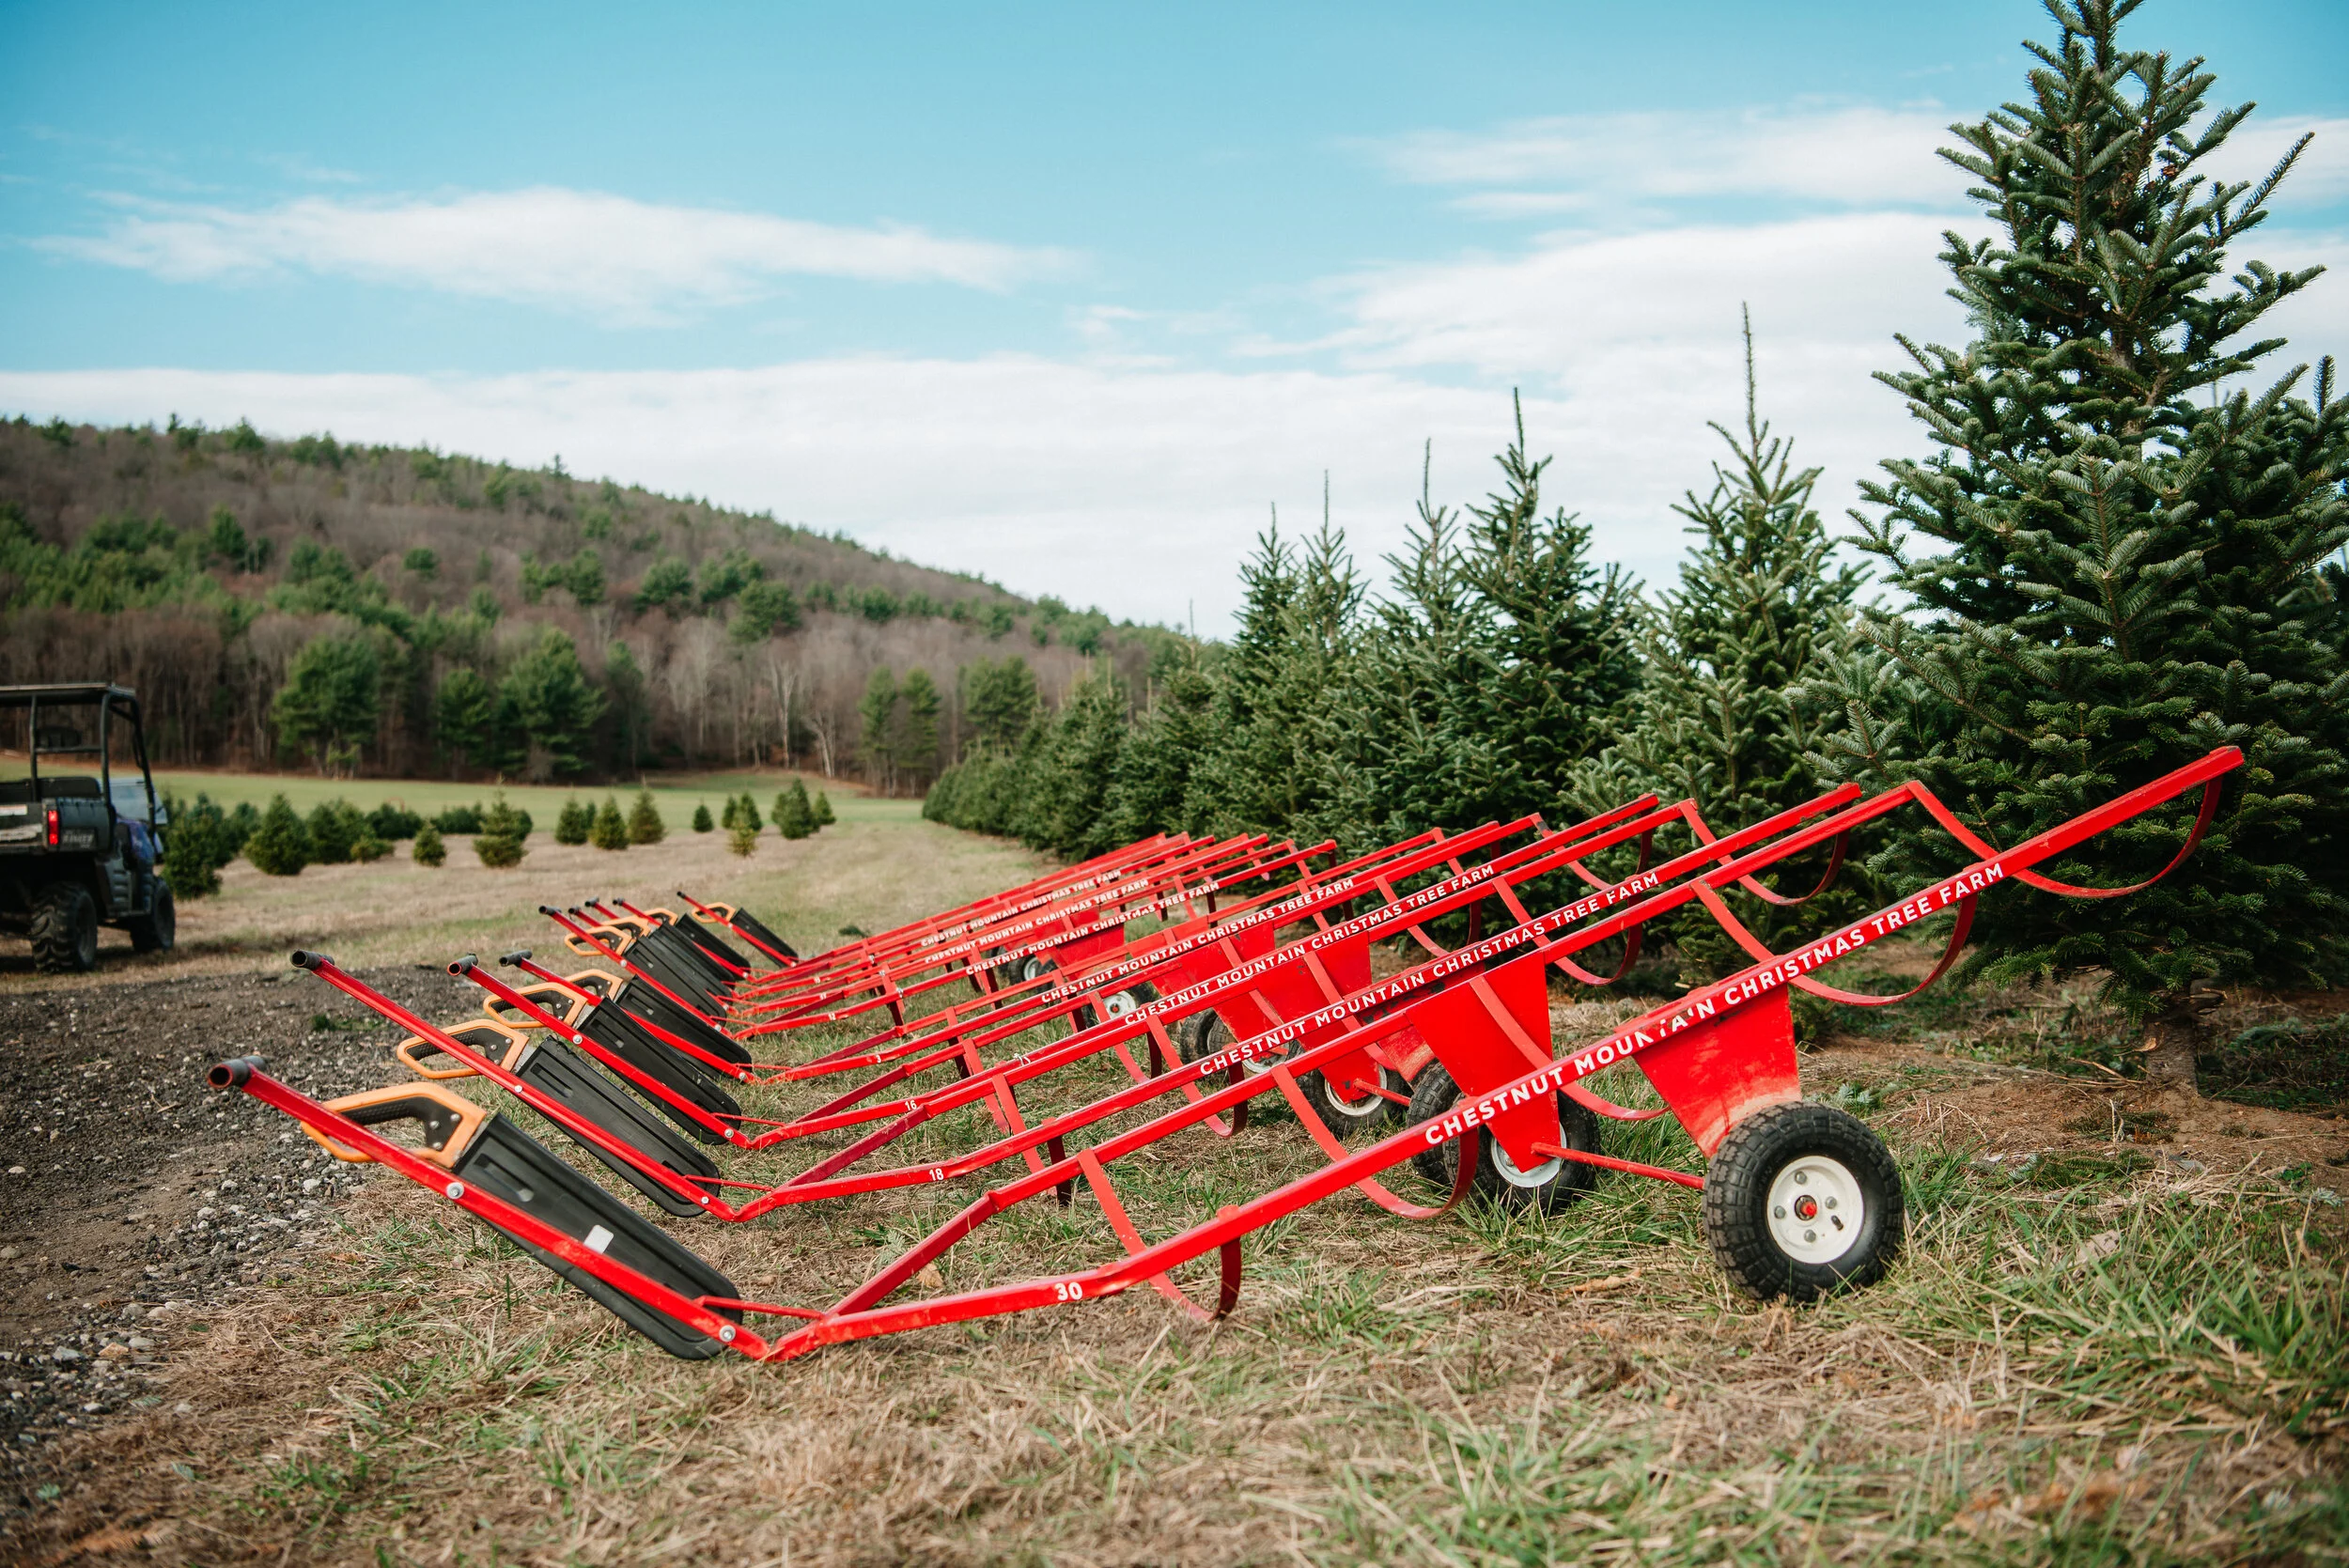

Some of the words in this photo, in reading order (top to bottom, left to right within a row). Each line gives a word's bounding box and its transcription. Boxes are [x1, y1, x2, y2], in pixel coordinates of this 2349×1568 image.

[966, 949, 1024, 975] CHESTNUT
[1028, 926, 1089, 954] MOUNTAIN
[1092, 905, 1156, 931] CHRISTMAS
[1159, 893, 1186, 909] TREE
[1189, 882, 1220, 898] FARM
[979, 921, 1033, 945] MOUNTAIN
[1035, 900, 1092, 925] CHRISTMAS
[1094, 892, 1119, 904] TREE
[1121, 879, 1148, 894] FARM
[1118, 940, 1192, 977] MOUNTAIN
[1198, 908, 1274, 944] CHRISTMAS
[1278, 894, 1313, 913] TREE
[1316, 878, 1353, 900] FARM
[1125, 983, 1209, 1024] CHESTNUT
[1217, 944, 1305, 988] MOUNTAIN
[1311, 904, 1403, 949] CHRISTMAS
[1407, 885, 1447, 907] TREE
[1451, 864, 1494, 892] FARM
[1200, 1021, 1306, 1075] CHESTNUT
[1315, 971, 1425, 1027] MOUNTAIN
[1432, 922, 1545, 978] CHRISTMAS
[1550, 898, 1600, 927] TREE
[1606, 872, 1659, 905] FARM
[1425, 1067, 1563, 1144] CHESTNUT
[1724, 929, 1865, 1005] CHRISTMAS
[1872, 897, 1933, 935] TREE
[1939, 862, 2003, 905] FARM
[905, 1099, 917, 1110] 16
[928, 1168, 944, 1181] 18
[1054, 1282, 1082, 1300] 30
